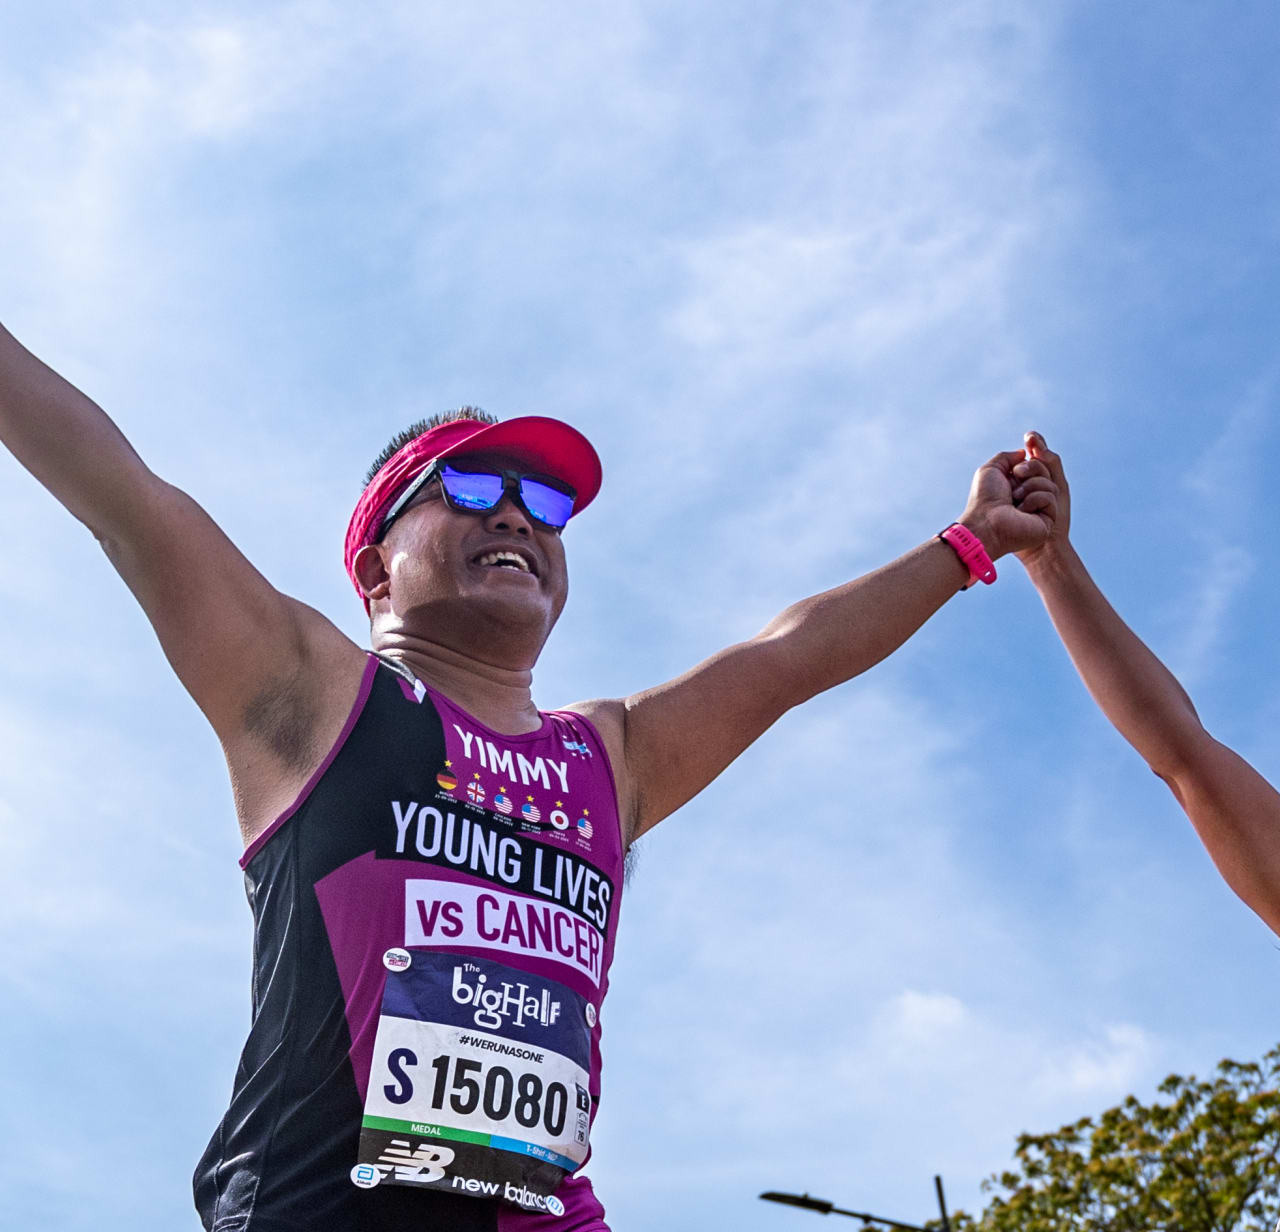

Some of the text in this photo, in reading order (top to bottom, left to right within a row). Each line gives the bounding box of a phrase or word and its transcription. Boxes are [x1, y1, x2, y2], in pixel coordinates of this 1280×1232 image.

[453, 724, 569, 793] YIMMY
[391, 801, 611, 931] YOUNG LIVES
[476, 893, 601, 979] CANCER
[463, 963, 480, 973] The
[459, 1035, 544, 1064] #WERUNASONE
[383, 1048, 568, 1137] S 15080
[411, 1123, 441, 1136] MEDAL
[452, 1176, 548, 1210] new balanc
